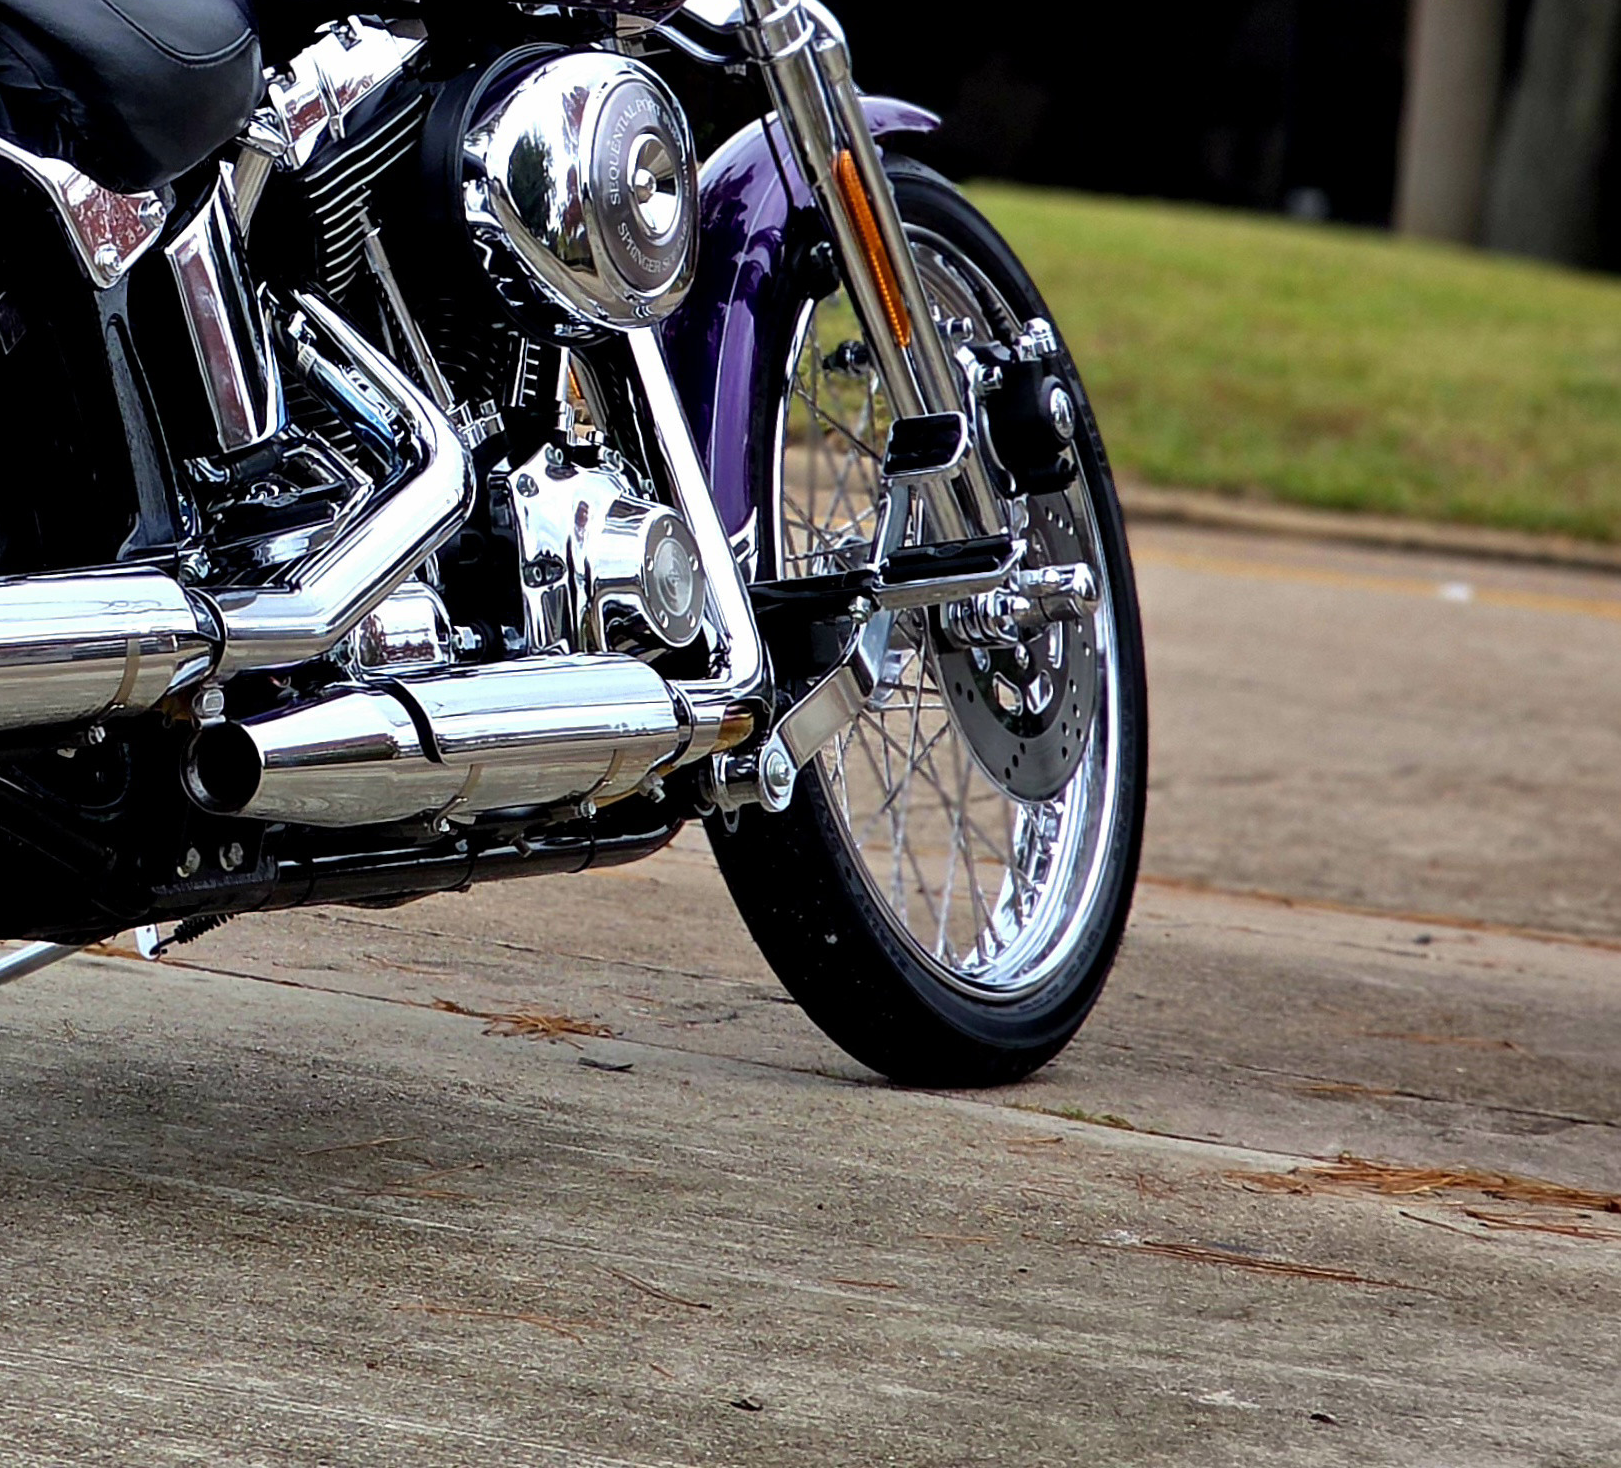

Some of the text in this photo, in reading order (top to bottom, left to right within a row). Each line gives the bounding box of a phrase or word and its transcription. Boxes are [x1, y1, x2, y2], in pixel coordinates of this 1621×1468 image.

[608, 98, 661, 206] SEQUENTIAL PORT
[617, 222, 662, 273] SPRINGER
